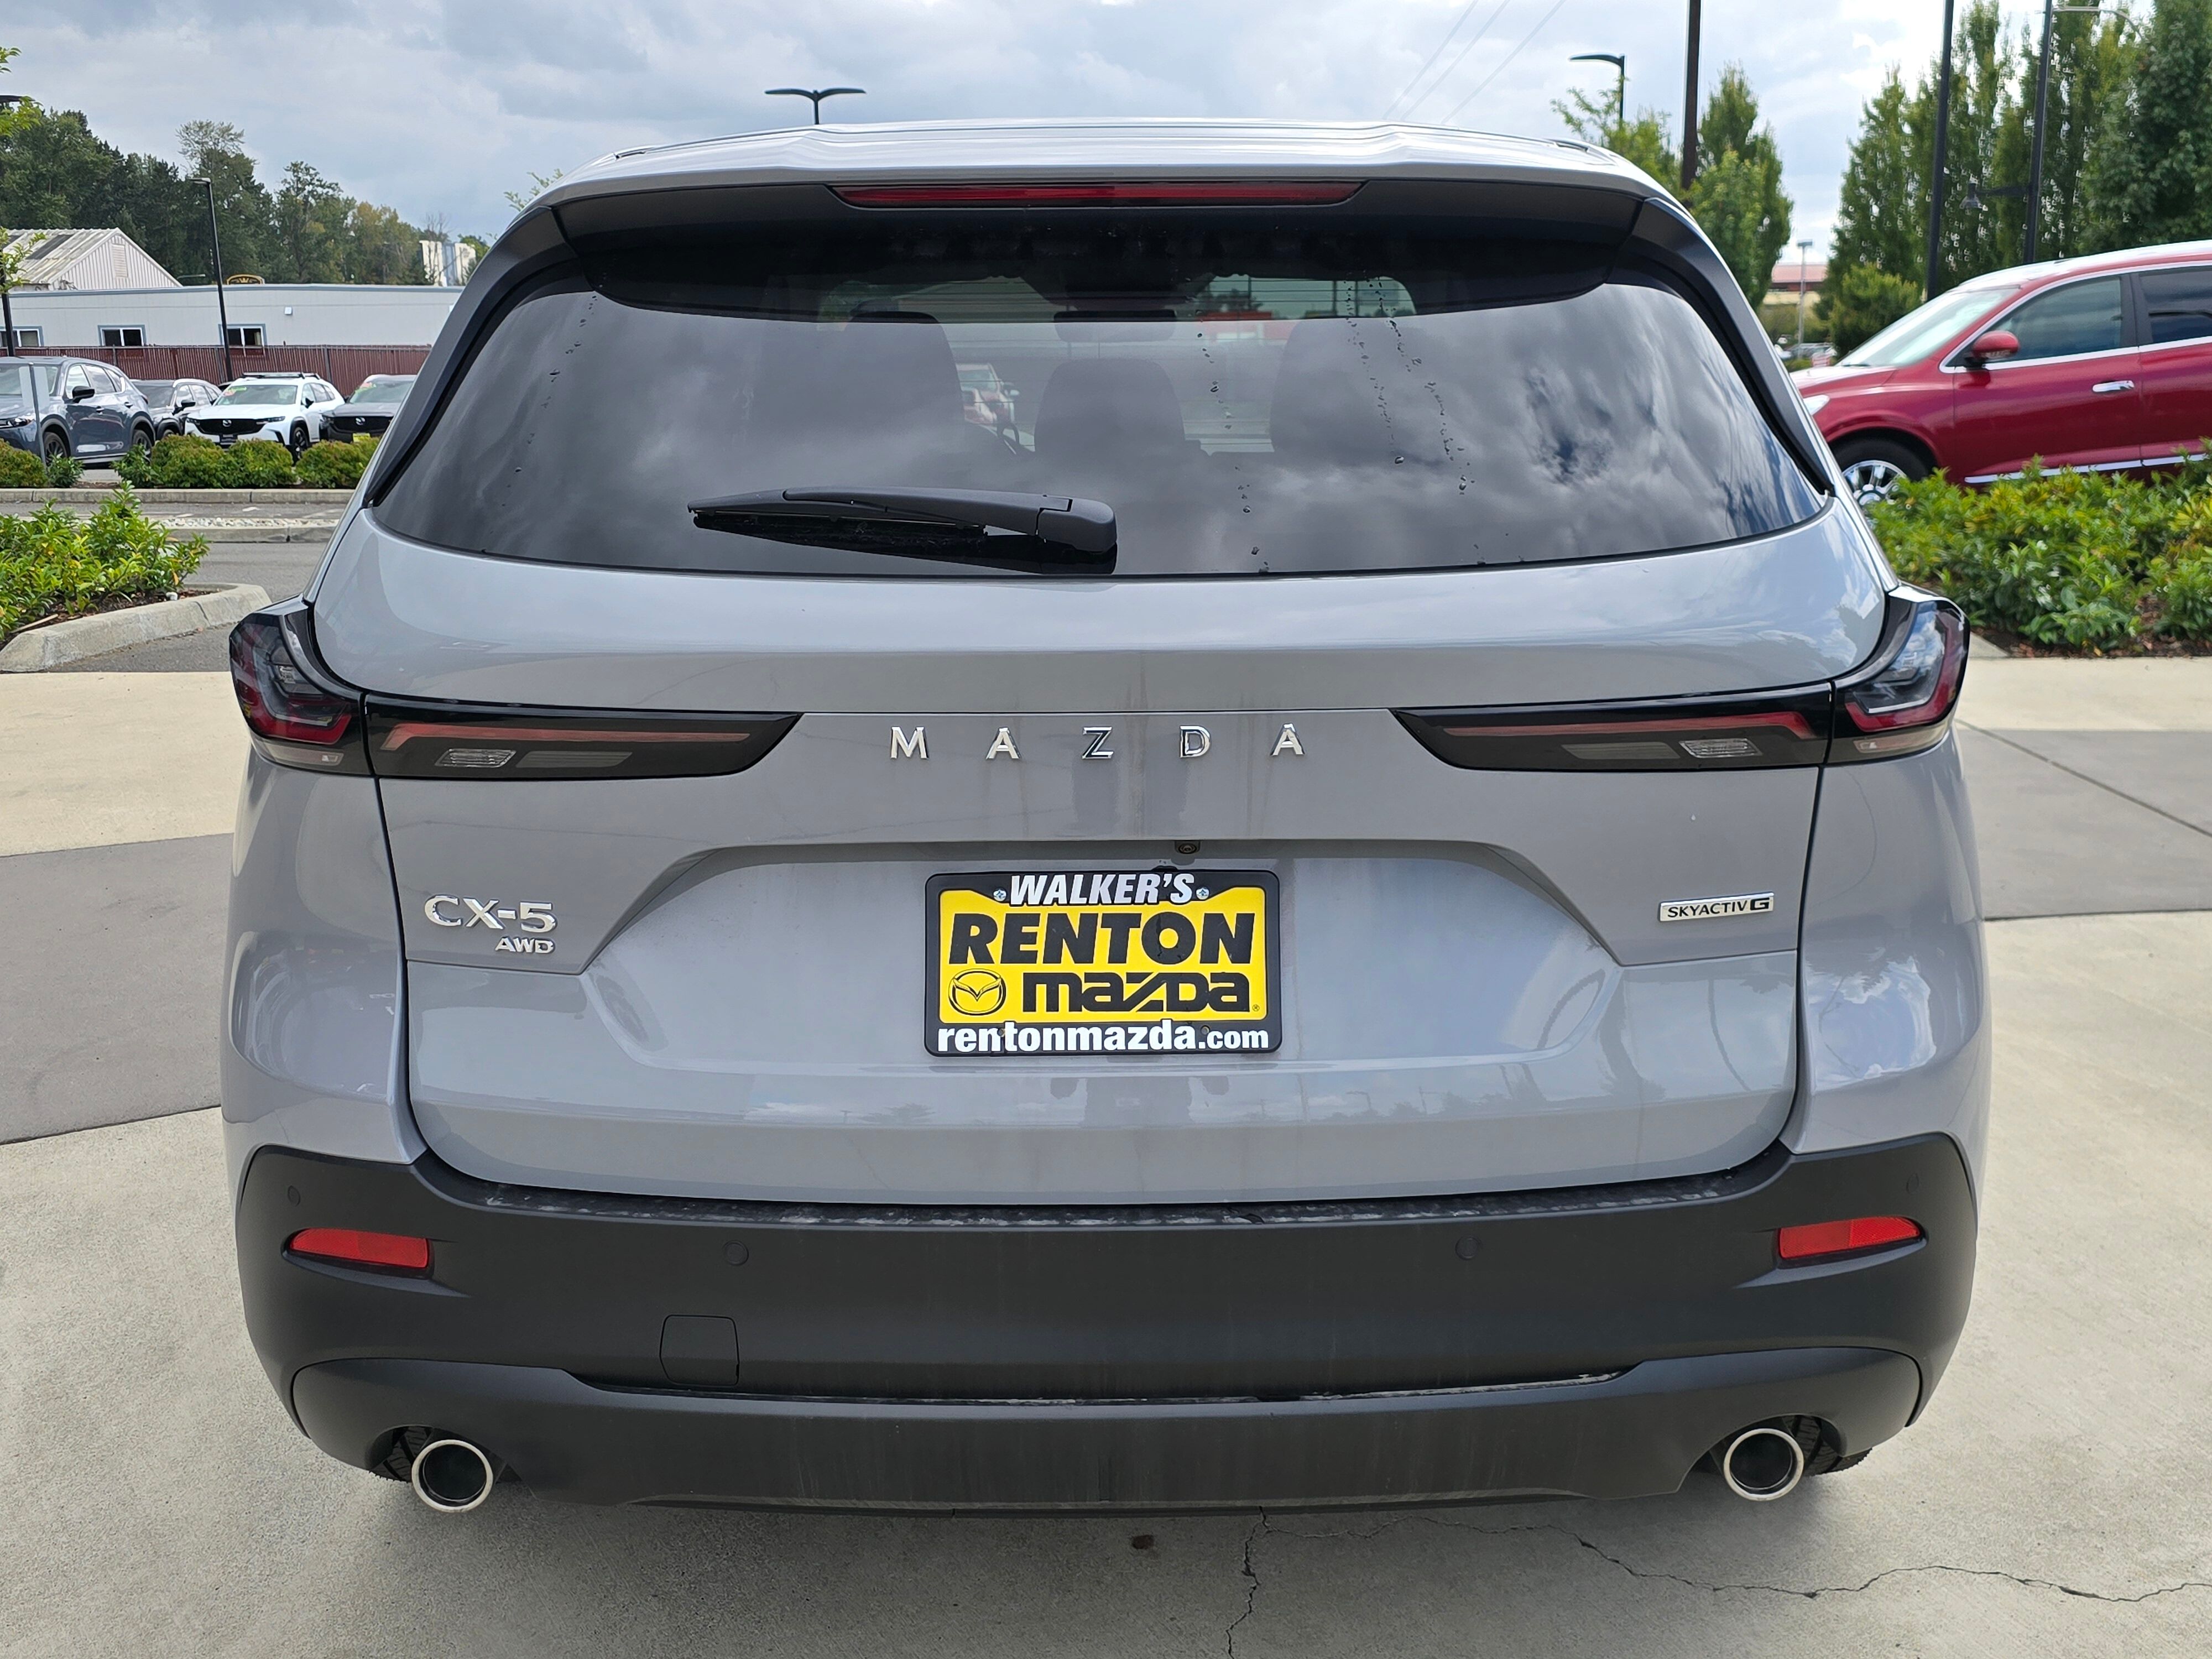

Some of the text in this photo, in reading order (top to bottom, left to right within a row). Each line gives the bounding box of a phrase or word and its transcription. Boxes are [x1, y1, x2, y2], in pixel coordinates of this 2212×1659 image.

[890, 723, 1306, 760] MAZDA
[1009, 874, 1194, 906] WALKER'S
[424, 894, 556, 933] CX-5
[494, 937, 555, 954] AWD
[948, 911, 1255, 964] RENTON
[938, 1019, 1269, 1052] rentonmazda.com
